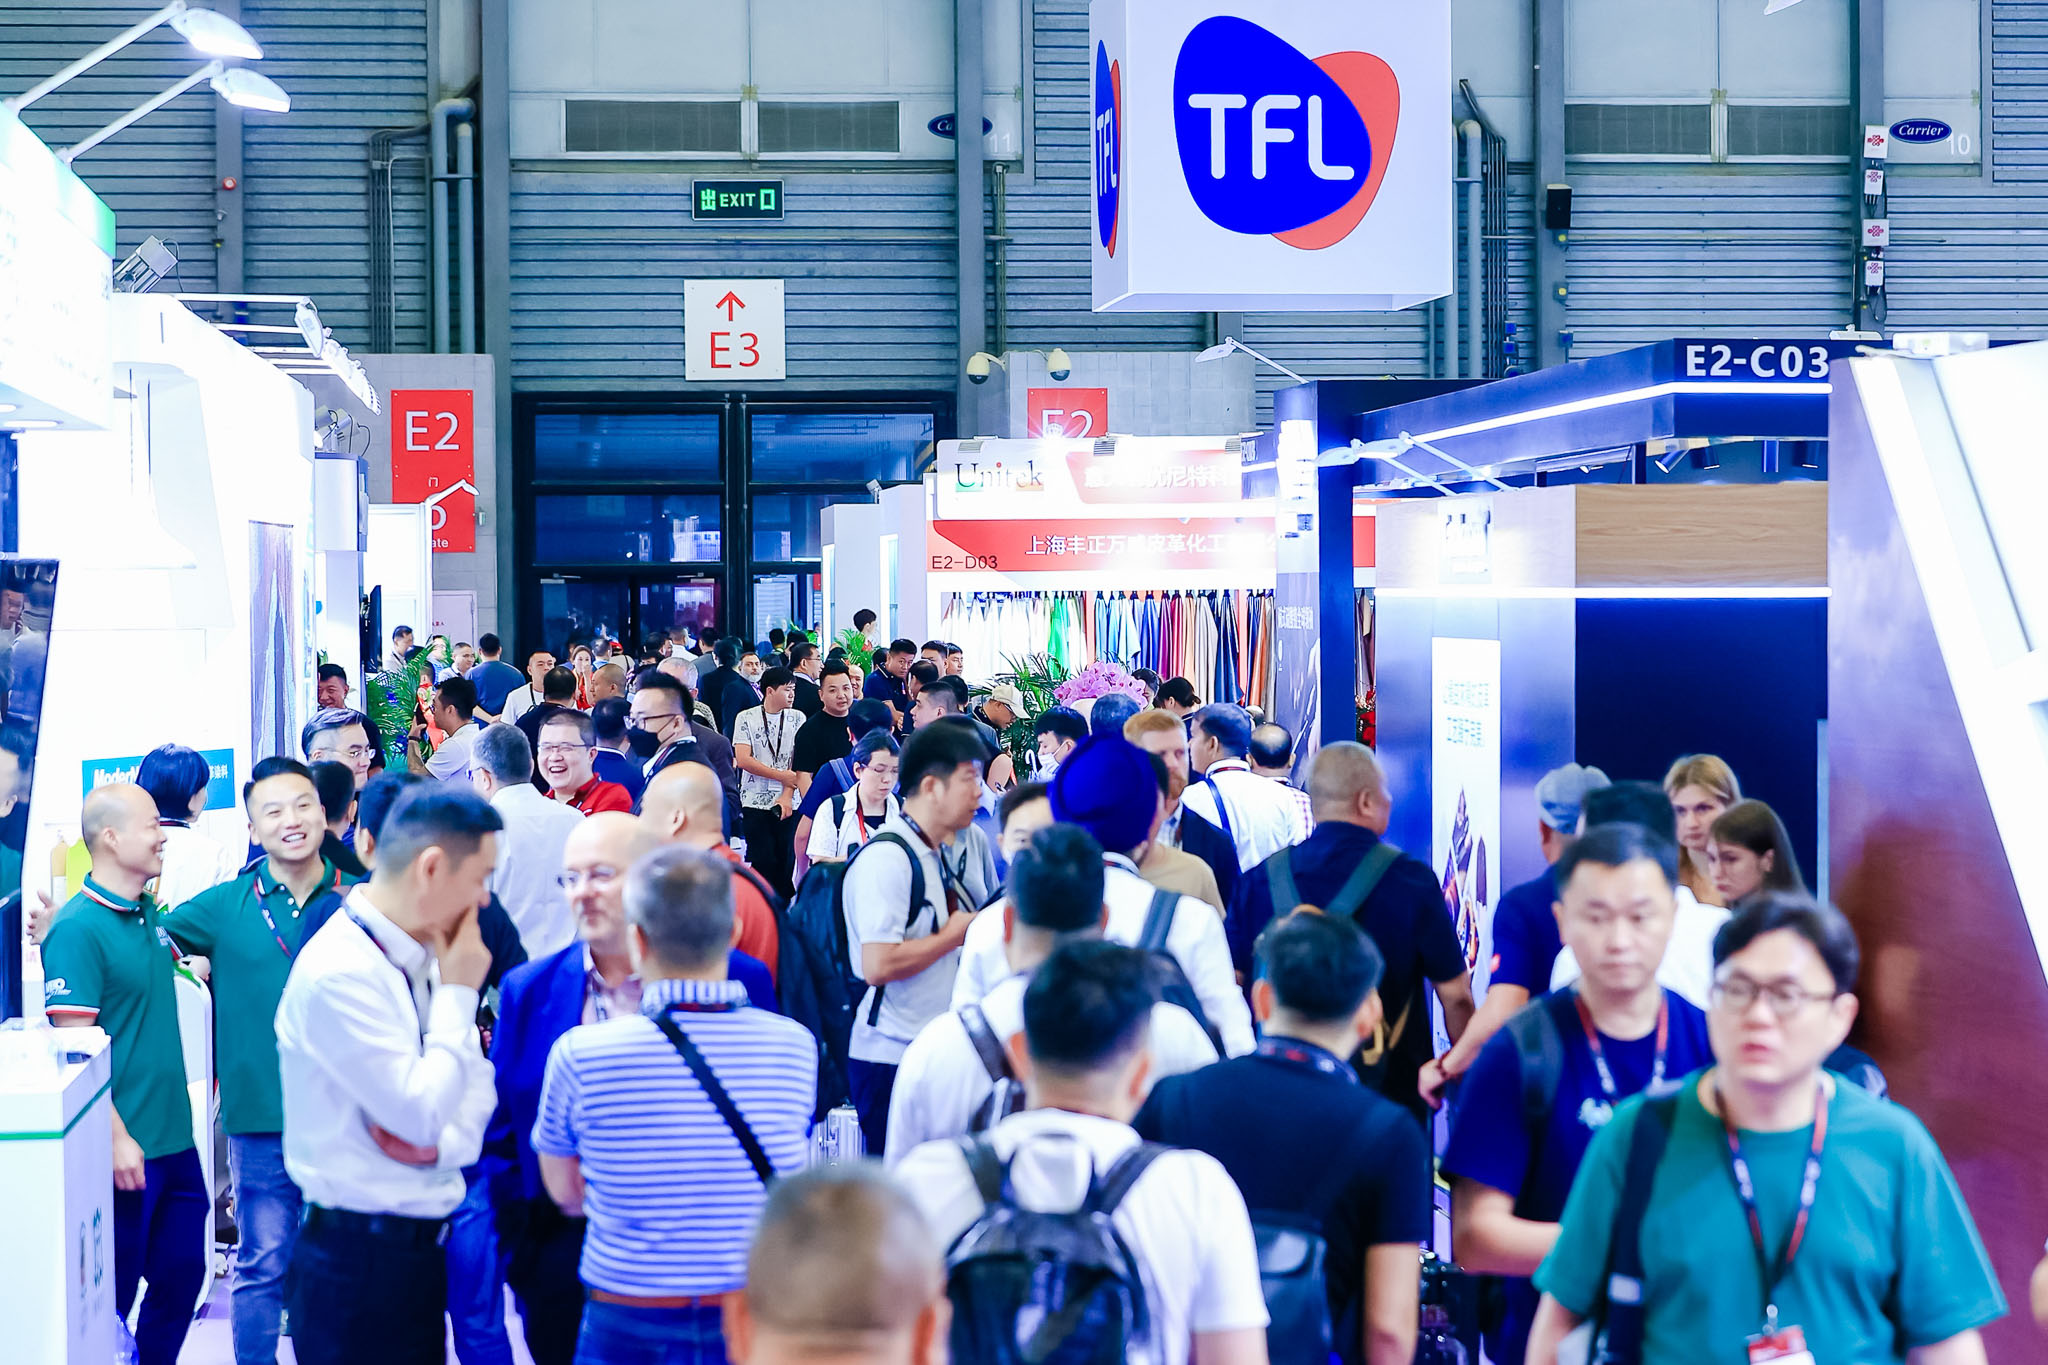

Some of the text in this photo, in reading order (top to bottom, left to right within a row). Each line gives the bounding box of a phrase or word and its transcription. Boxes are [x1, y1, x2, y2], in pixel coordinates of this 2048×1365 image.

[1188, 94, 1355, 180] TFL
[1898, 125, 1944, 136] Carrier
[1096, 107, 1117, 196] TFL
[701, 189, 716, 211] 出
[720, 193, 756, 207] EXIT
[710, 332, 760, 369] E3
[1686, 344, 1829, 379] E2-C03
[405, 410, 460, 451] E2
[431, 538, 449, 548] ate
[932, 555, 998, 570] E2-D03
